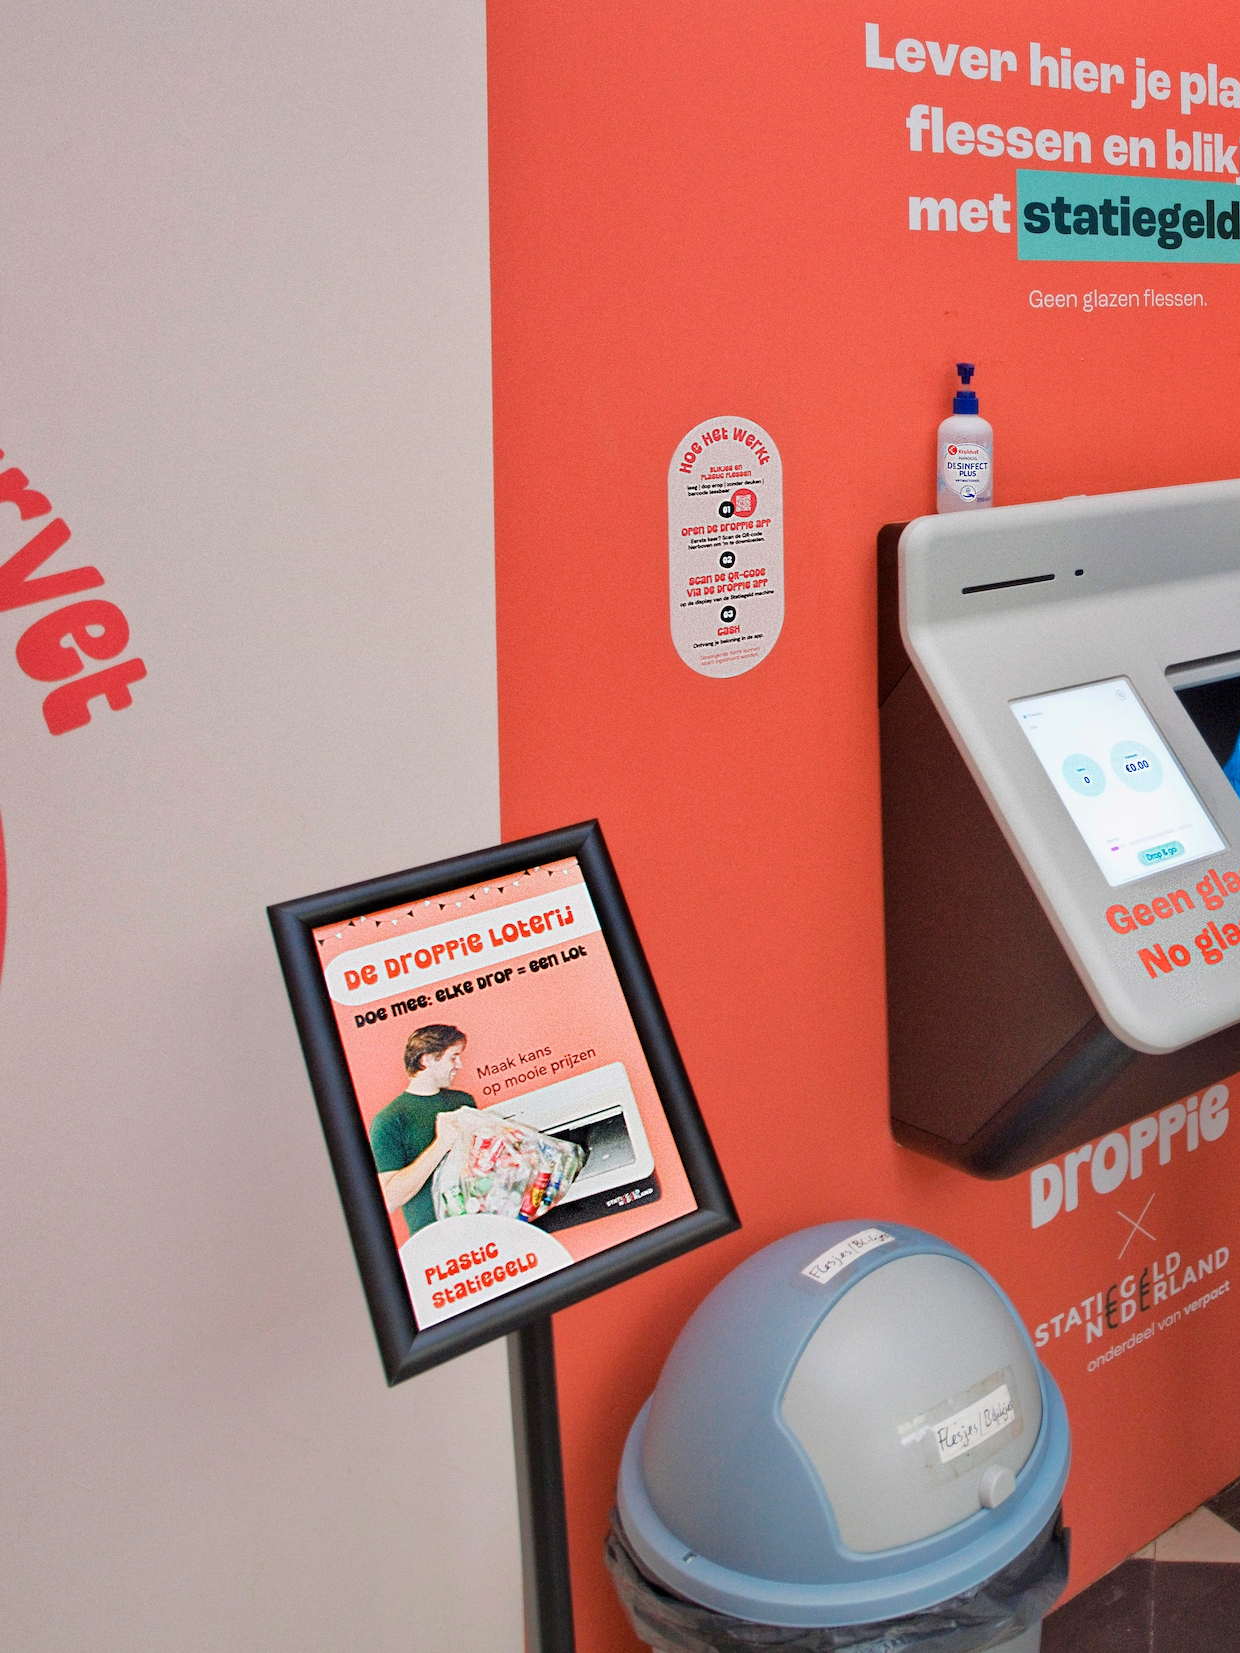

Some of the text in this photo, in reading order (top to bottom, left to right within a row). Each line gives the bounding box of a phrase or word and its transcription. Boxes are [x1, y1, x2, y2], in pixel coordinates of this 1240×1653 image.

[864, 22, 1017, 82] Lever
[1030, 42, 1124, 94] hier
[1131, 57, 1171, 109] je
[905, 104, 1091, 164] flessen
[1103, 132, 1156, 169] en
[908, 193, 1011, 233] met
[1023, 195, 1240, 249] statiegeld
[1029, 289, 1208, 312] Geen glazen flessen.
[947, 461, 988, 470] DESINFECT
[722, 505, 731, 514] 01
[722, 555, 733, 564] 02
[723, 609, 734, 618] 03
[1083, 776, 1091, 784] 0
[1125, 759, 1150, 773] €0.00
[1145, 852, 1163, 861] Drop
[1167, 847, 1178, 856] go
[1105, 888, 1196, 935] Geen
[1136, 943, 1192, 979] No
[476, 1045, 552, 1080] Maak kans
[482, 1047, 596, 1098] op mooie prijzen
[1087, 1279, 1231, 1373] onderdeel van verpact
